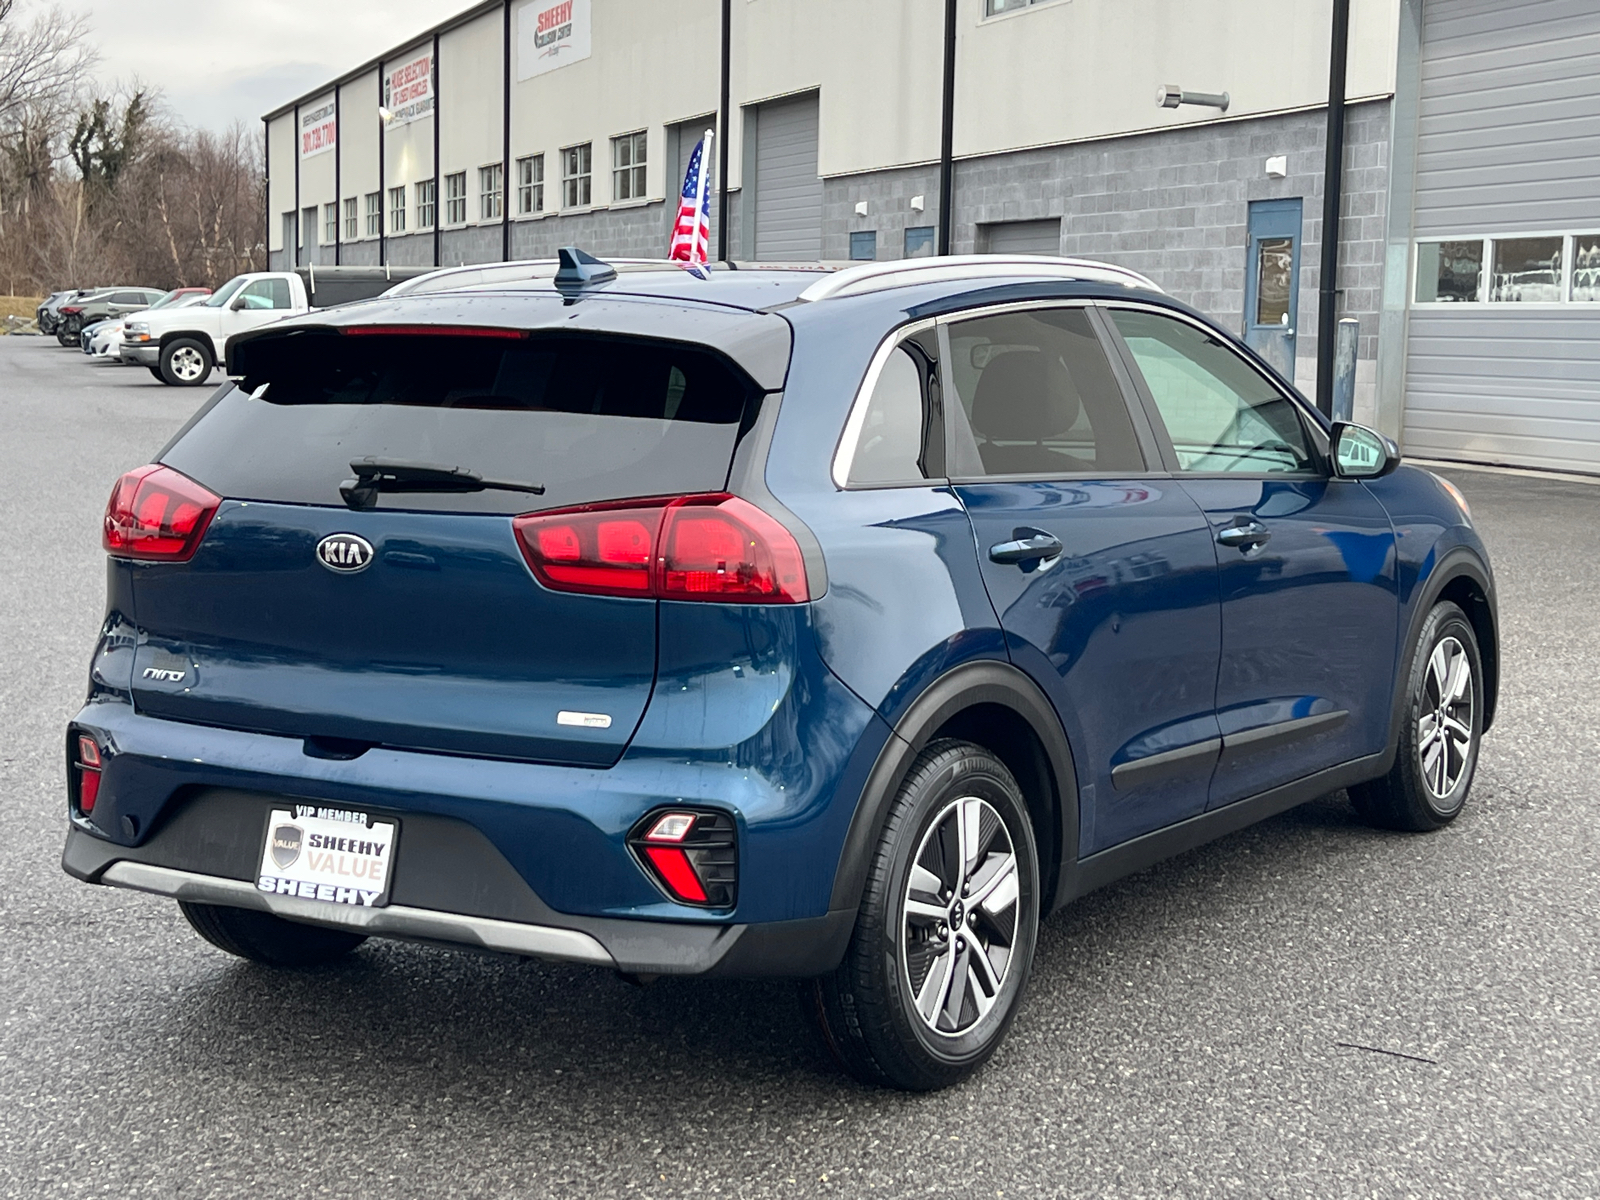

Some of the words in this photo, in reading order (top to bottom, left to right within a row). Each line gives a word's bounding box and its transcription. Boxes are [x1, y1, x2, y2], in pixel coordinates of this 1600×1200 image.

[537, 0, 573, 33] SHEEHY
[391, 67, 405, 90] HUGE
[404, 56, 430, 85] SELECTION
[325, 541, 363, 564] KIA
[296, 804, 315, 817] VIP
[317, 807, 368, 824] MEMBER
[273, 838, 300, 850] VALUE
[308, 833, 386, 857] SHEEHY
[307, 851, 383, 880] VALUE
[257, 875, 381, 907] SHEEHY
